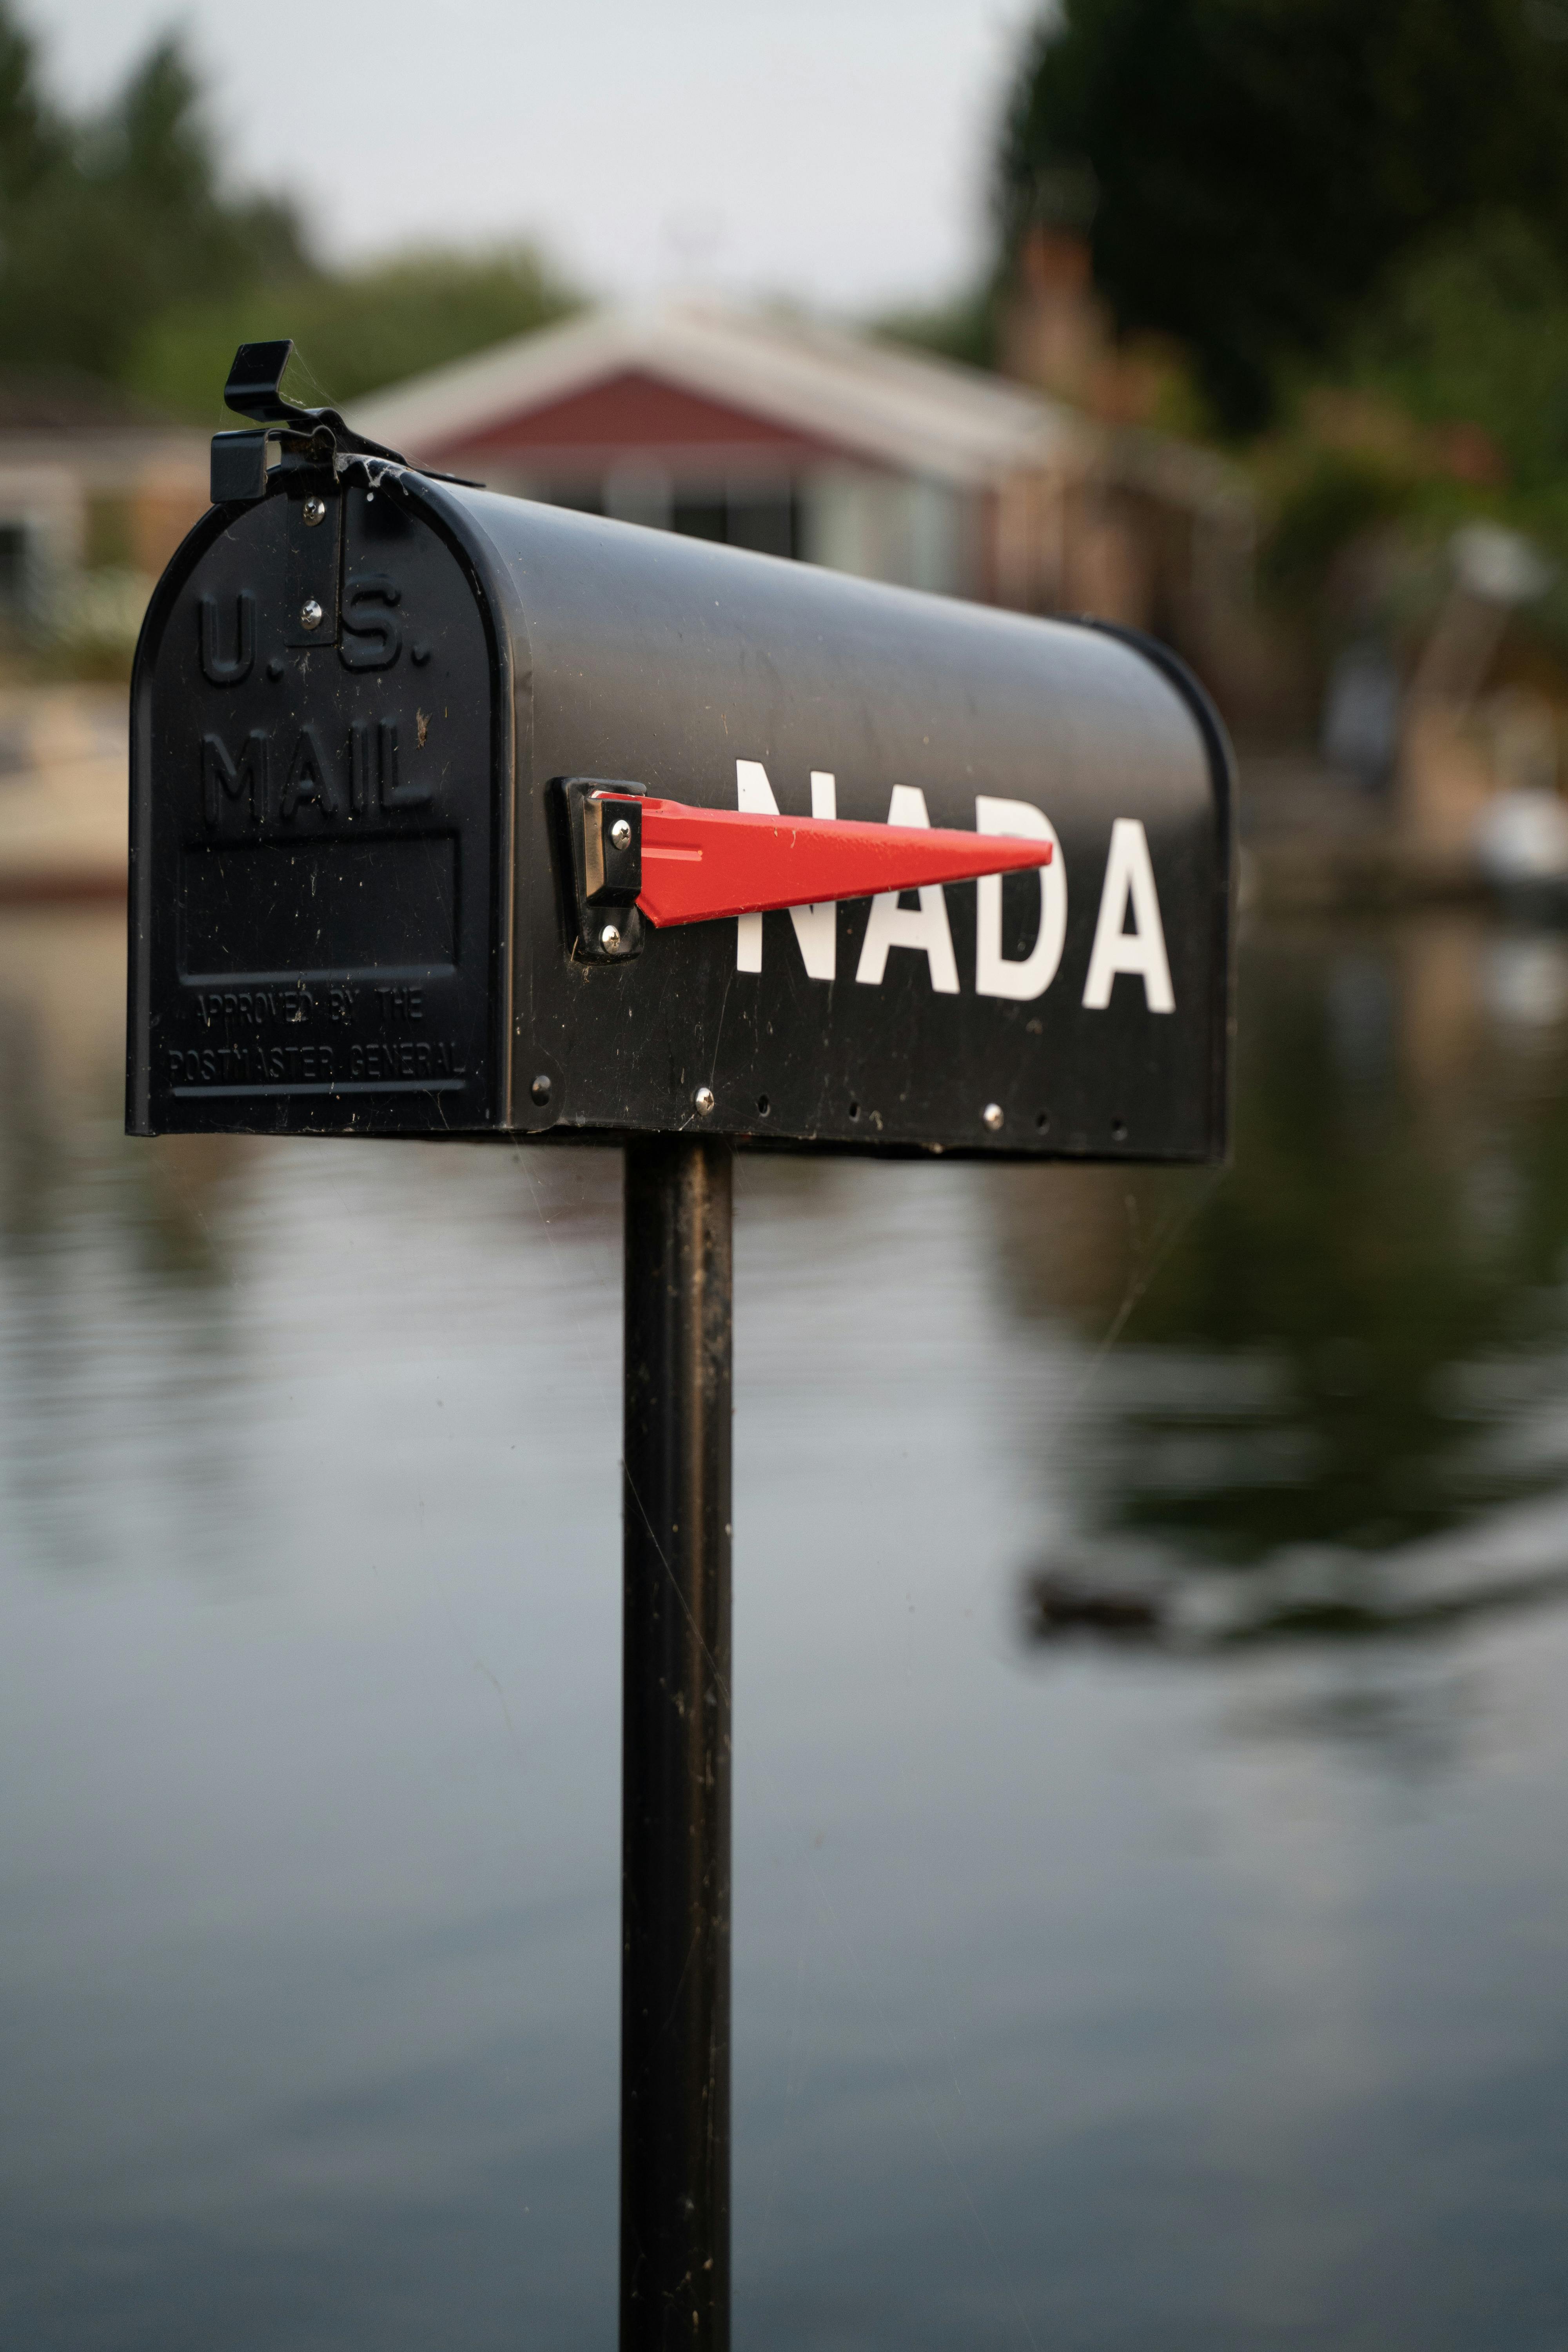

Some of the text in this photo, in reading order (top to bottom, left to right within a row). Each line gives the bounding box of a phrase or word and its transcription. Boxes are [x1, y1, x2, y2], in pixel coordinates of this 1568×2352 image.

[200, 715, 436, 830] MAIL
[735, 759, 1176, 1014] NADA
[197, 986, 424, 1024] APPROVED BY THE
[167, 1041, 467, 1082] POSTMASTER GENERAL
